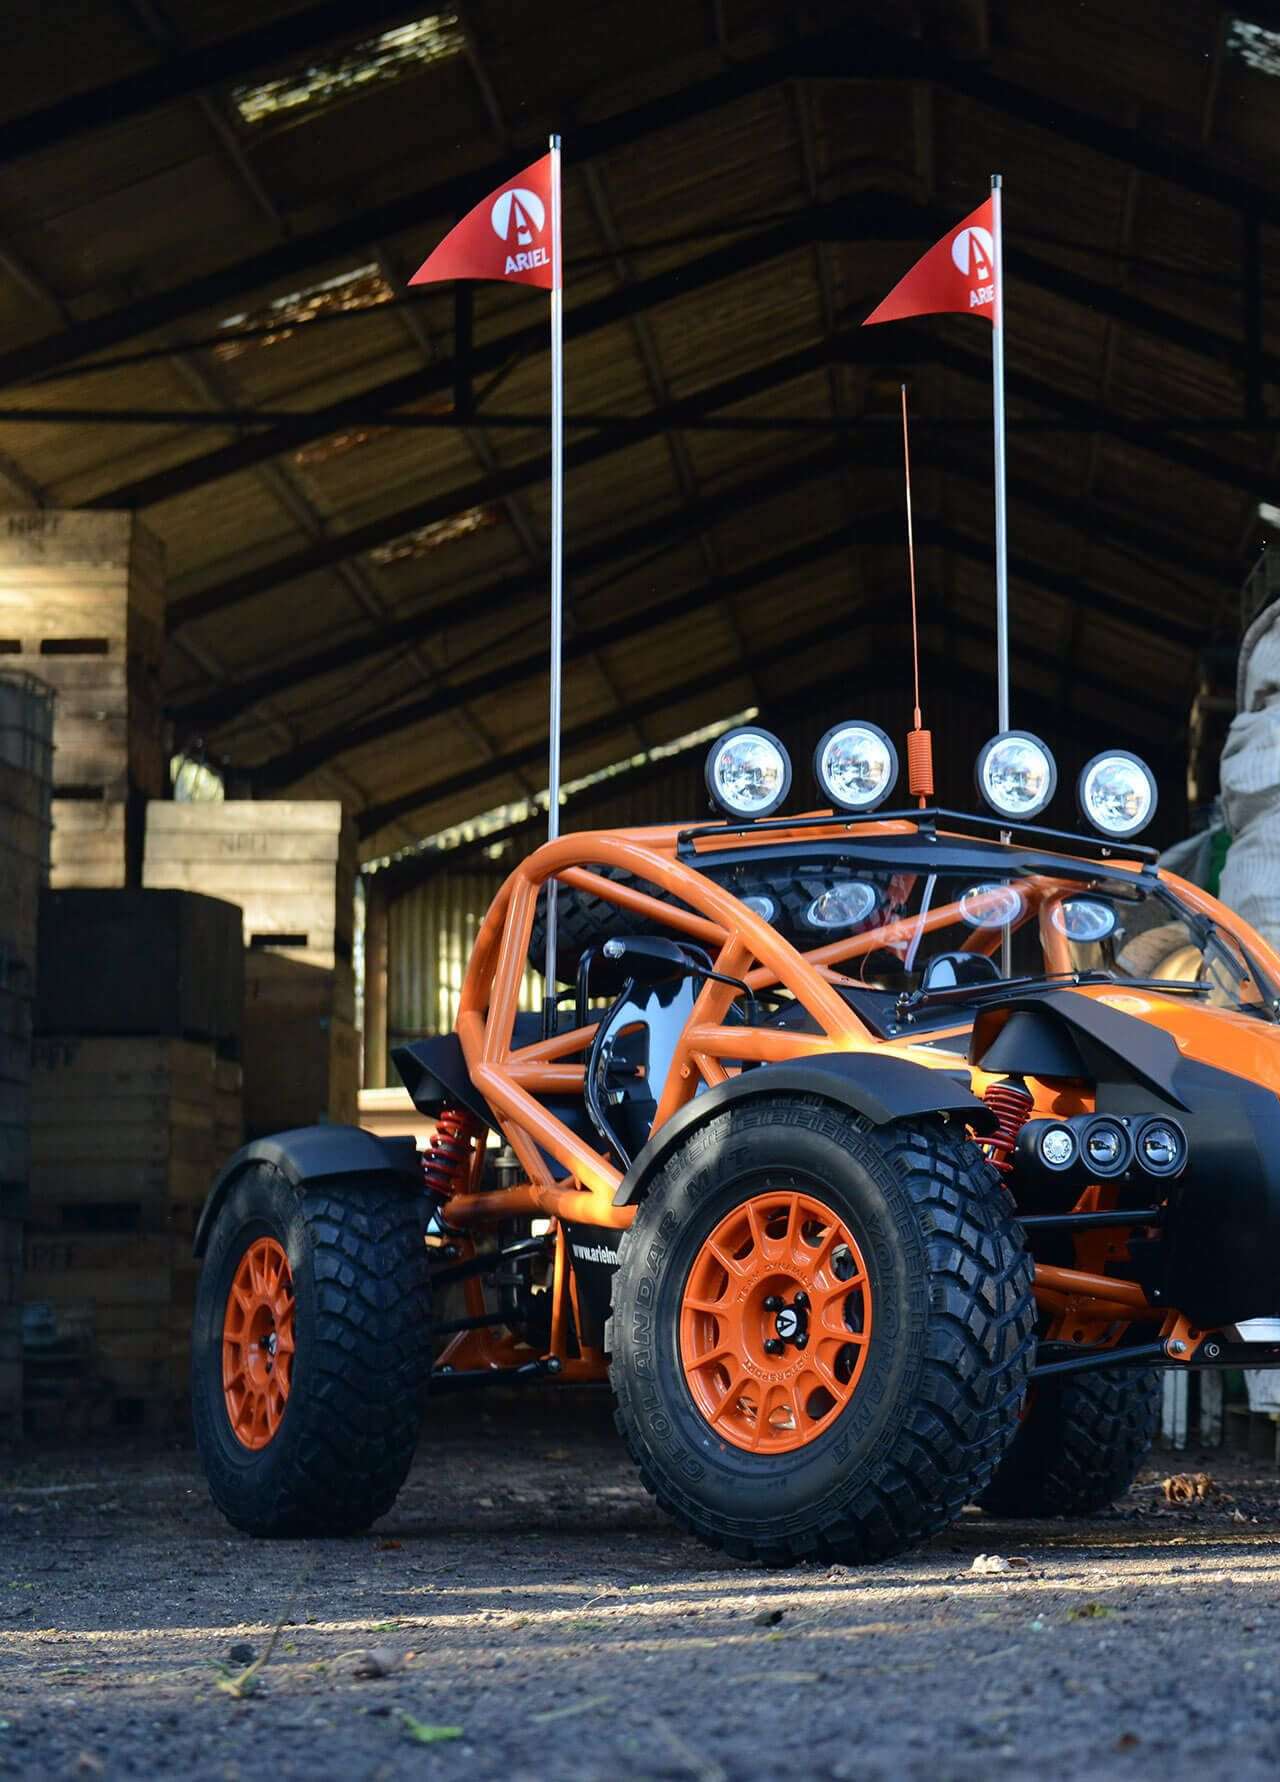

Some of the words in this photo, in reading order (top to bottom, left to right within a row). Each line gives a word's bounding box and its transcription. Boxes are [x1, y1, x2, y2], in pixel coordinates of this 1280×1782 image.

[504, 248, 550, 275] ARIEL
[969, 284, 995, 308] ARIE
[572, 1244, 619, 1266] www.arielm
[632, 1208, 706, 1482] GEOLANDAR
